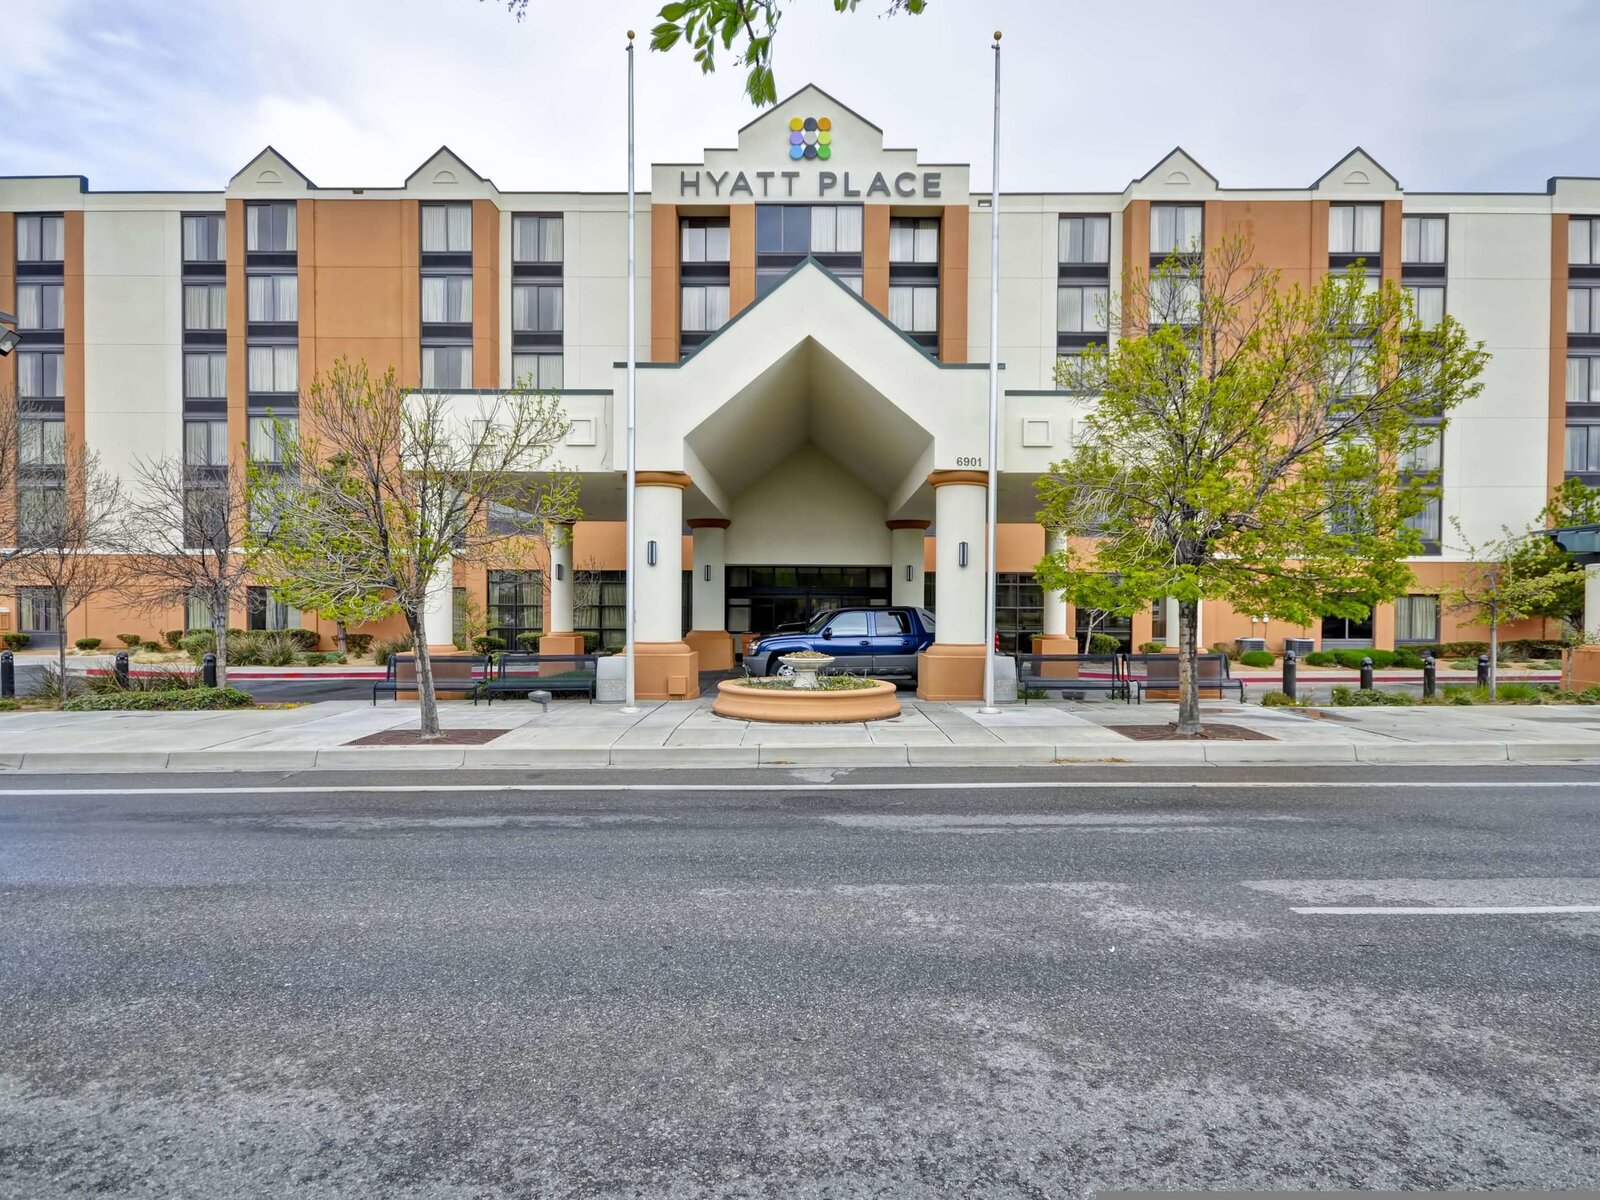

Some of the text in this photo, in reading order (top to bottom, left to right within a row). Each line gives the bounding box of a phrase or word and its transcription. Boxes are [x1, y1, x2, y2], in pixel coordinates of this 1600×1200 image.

[680, 171, 942, 198] HYATT PLACE
[956, 456, 982, 467] 6901
